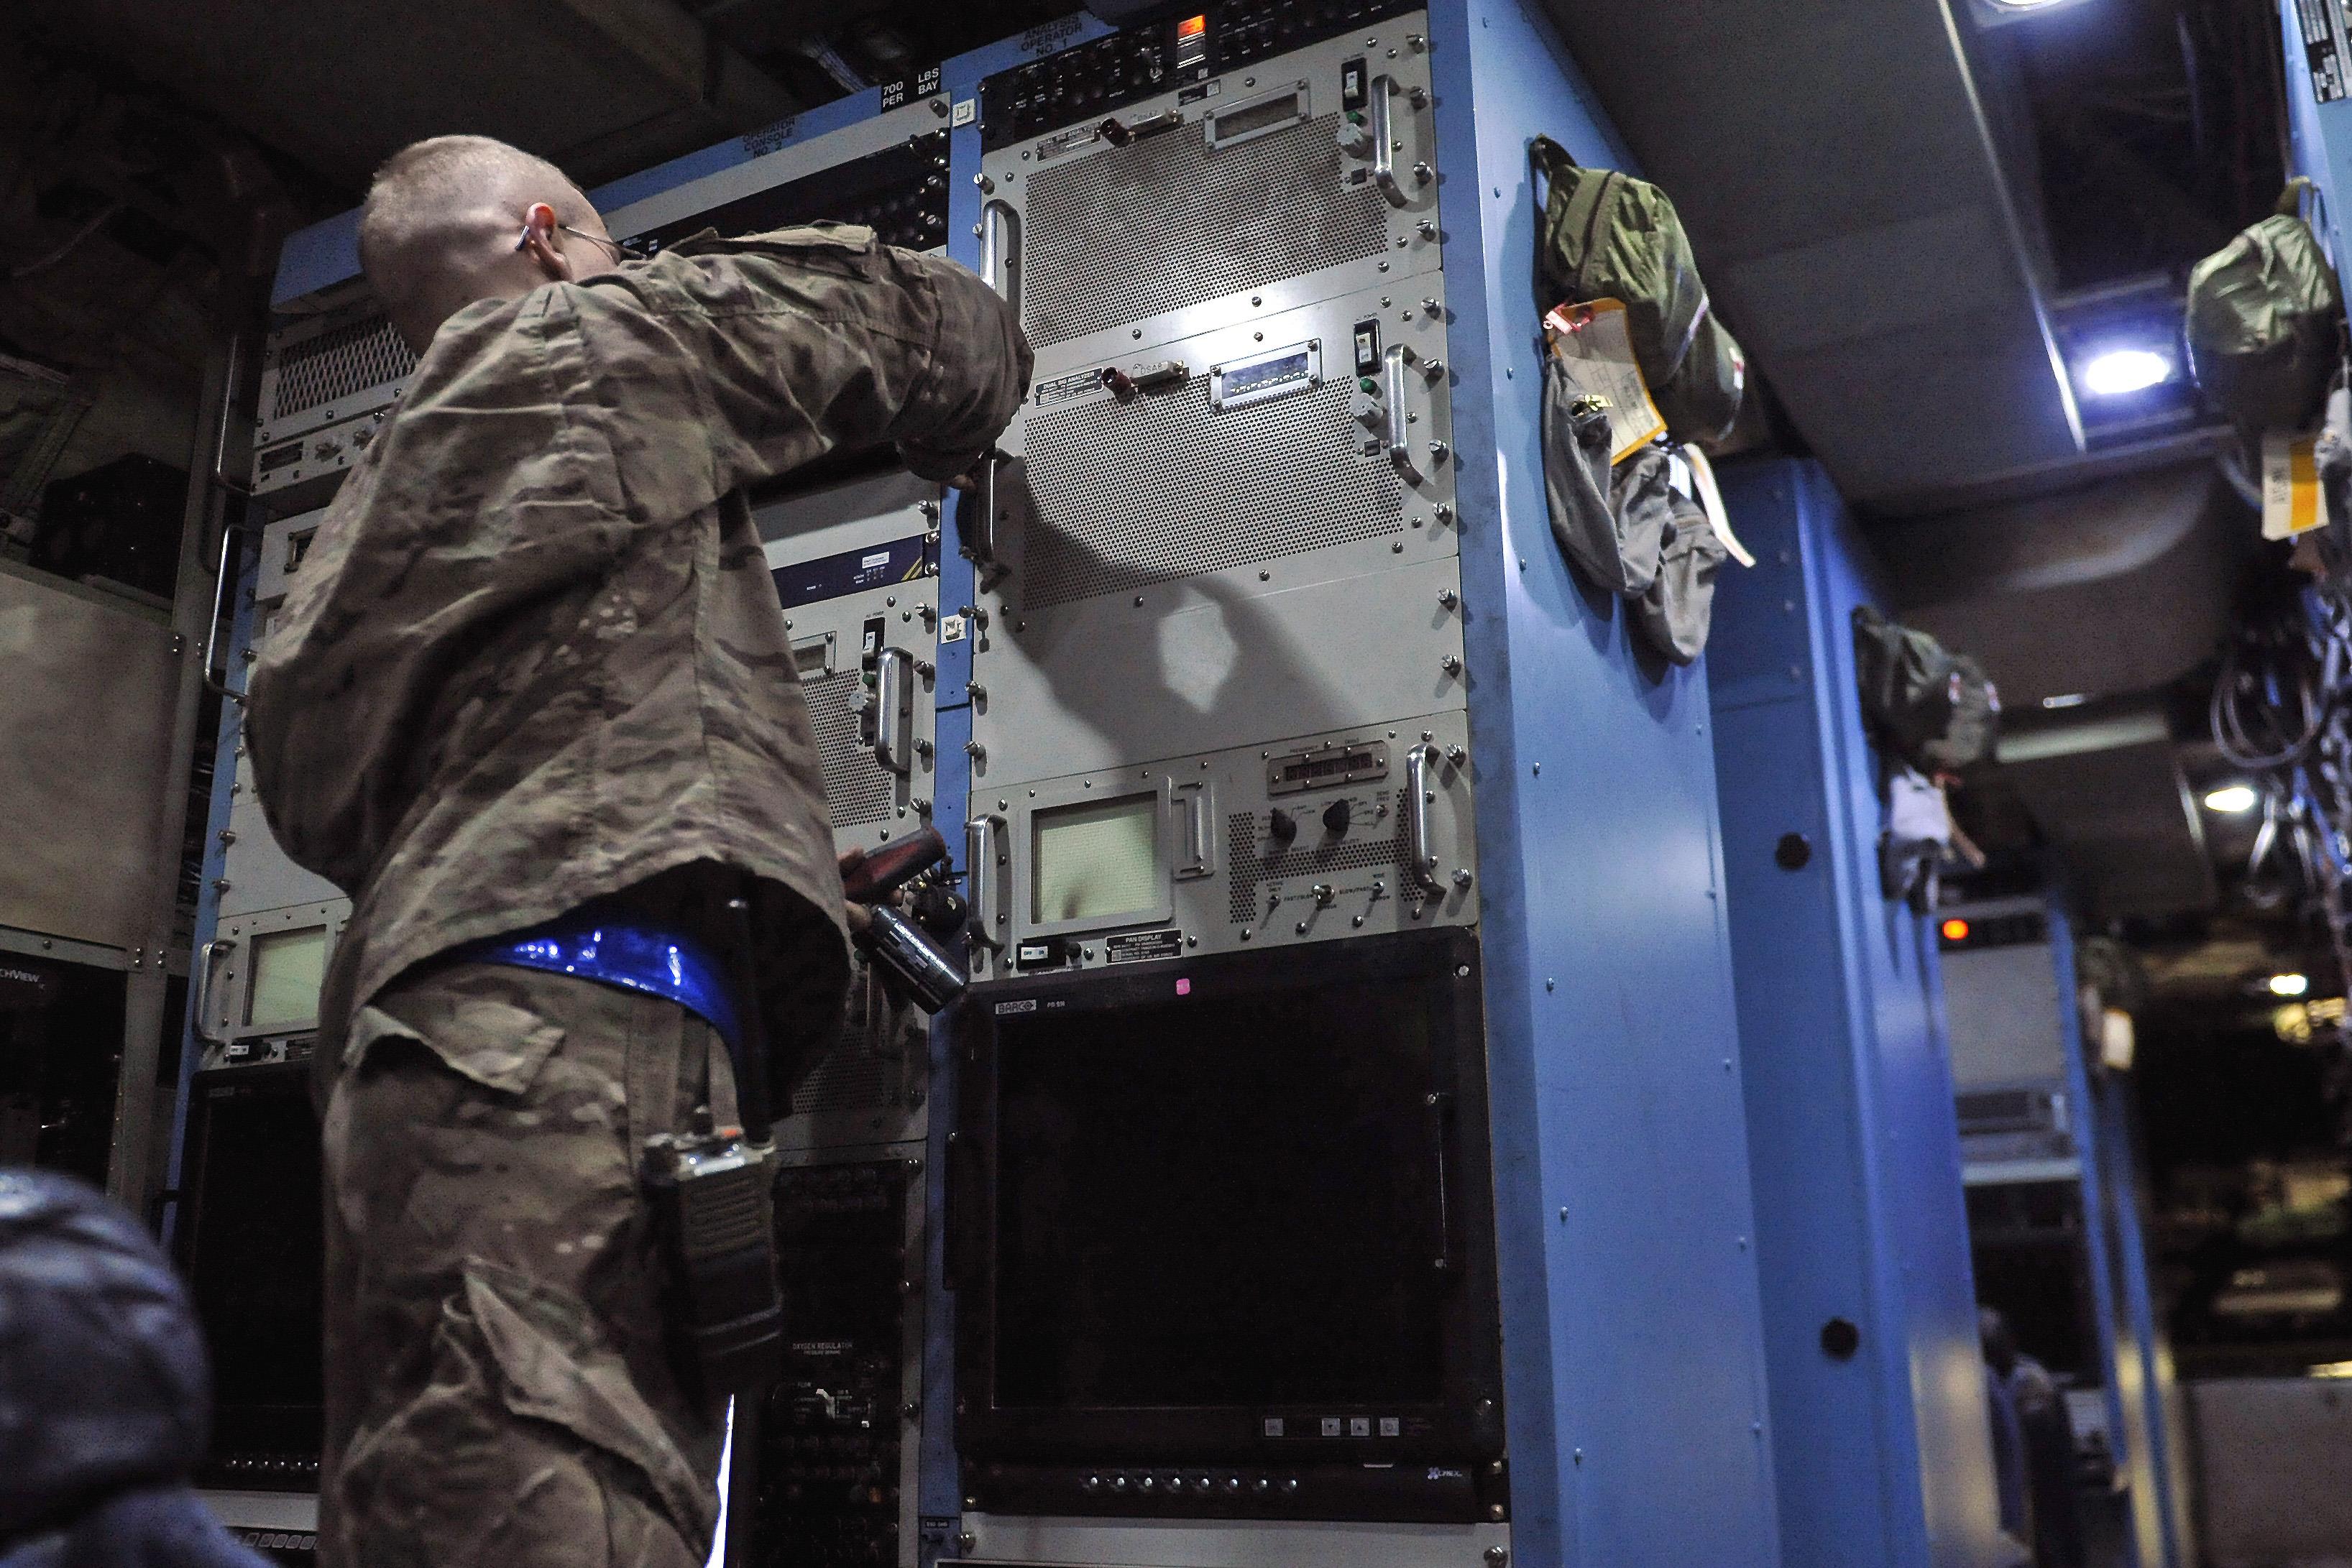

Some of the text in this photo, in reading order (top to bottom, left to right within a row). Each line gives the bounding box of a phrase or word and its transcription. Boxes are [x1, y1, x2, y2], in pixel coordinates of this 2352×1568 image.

[1021, 22, 1082, 51] OPERATOR
[883, 68, 940, 96] 700 LBS
[883, 79, 939, 108] PER BAY
[744, 127, 794, 152] CONSOLE
[1067, 372, 1095, 382] ANALYZER
[998, 1001, 1034, 1013] BARCO
